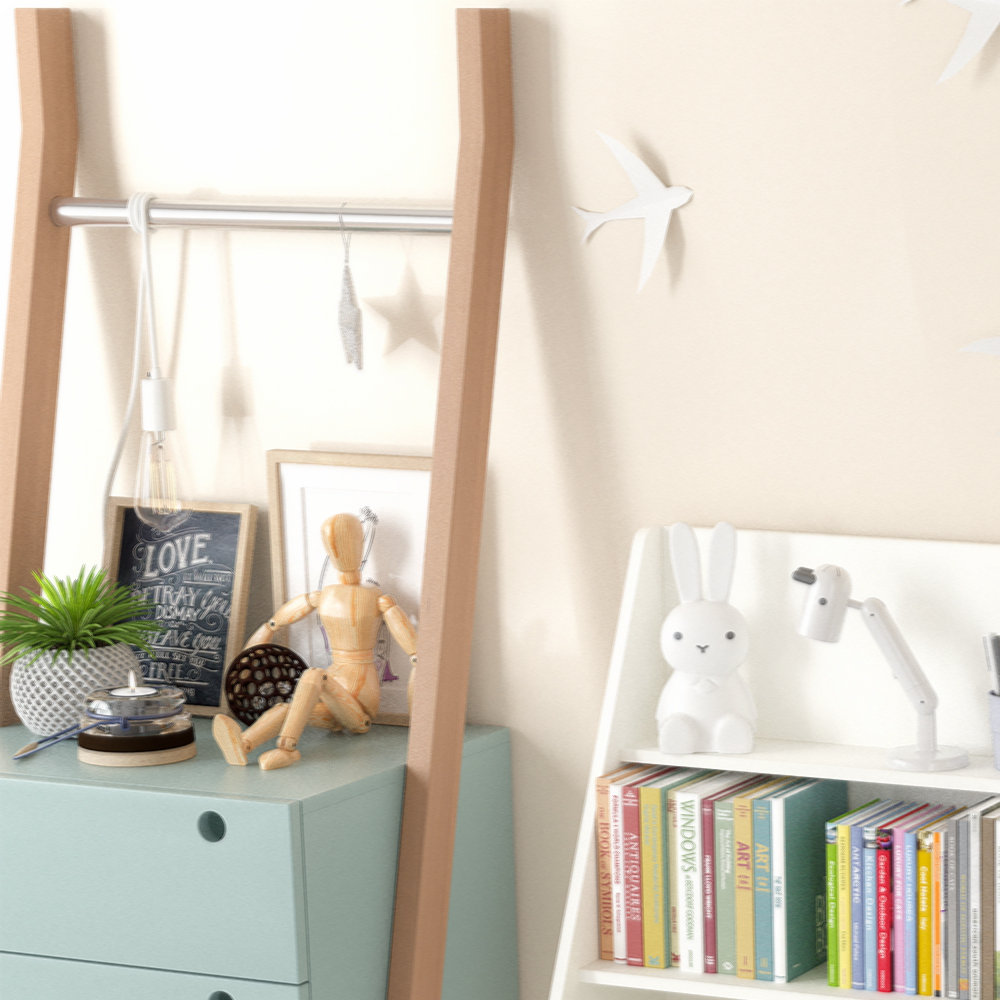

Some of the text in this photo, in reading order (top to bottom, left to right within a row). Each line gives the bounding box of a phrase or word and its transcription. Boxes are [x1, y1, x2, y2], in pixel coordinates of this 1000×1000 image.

[599, 822, 610, 857] BOOK
[680, 799, 697, 873] WINDOWS
[736, 841, 751, 871] ART
[755, 843, 769, 872] ART
[878, 855, 887, 884] Garden
[629, 832, 641, 921] ANTIQUAIRES
[852, 846, 861, 904] ANTARCTIC
[865, 855, 876, 931] Kitchen Design
[879, 895, 888, 929] Outdoor
[878, 932, 888, 959] Design
